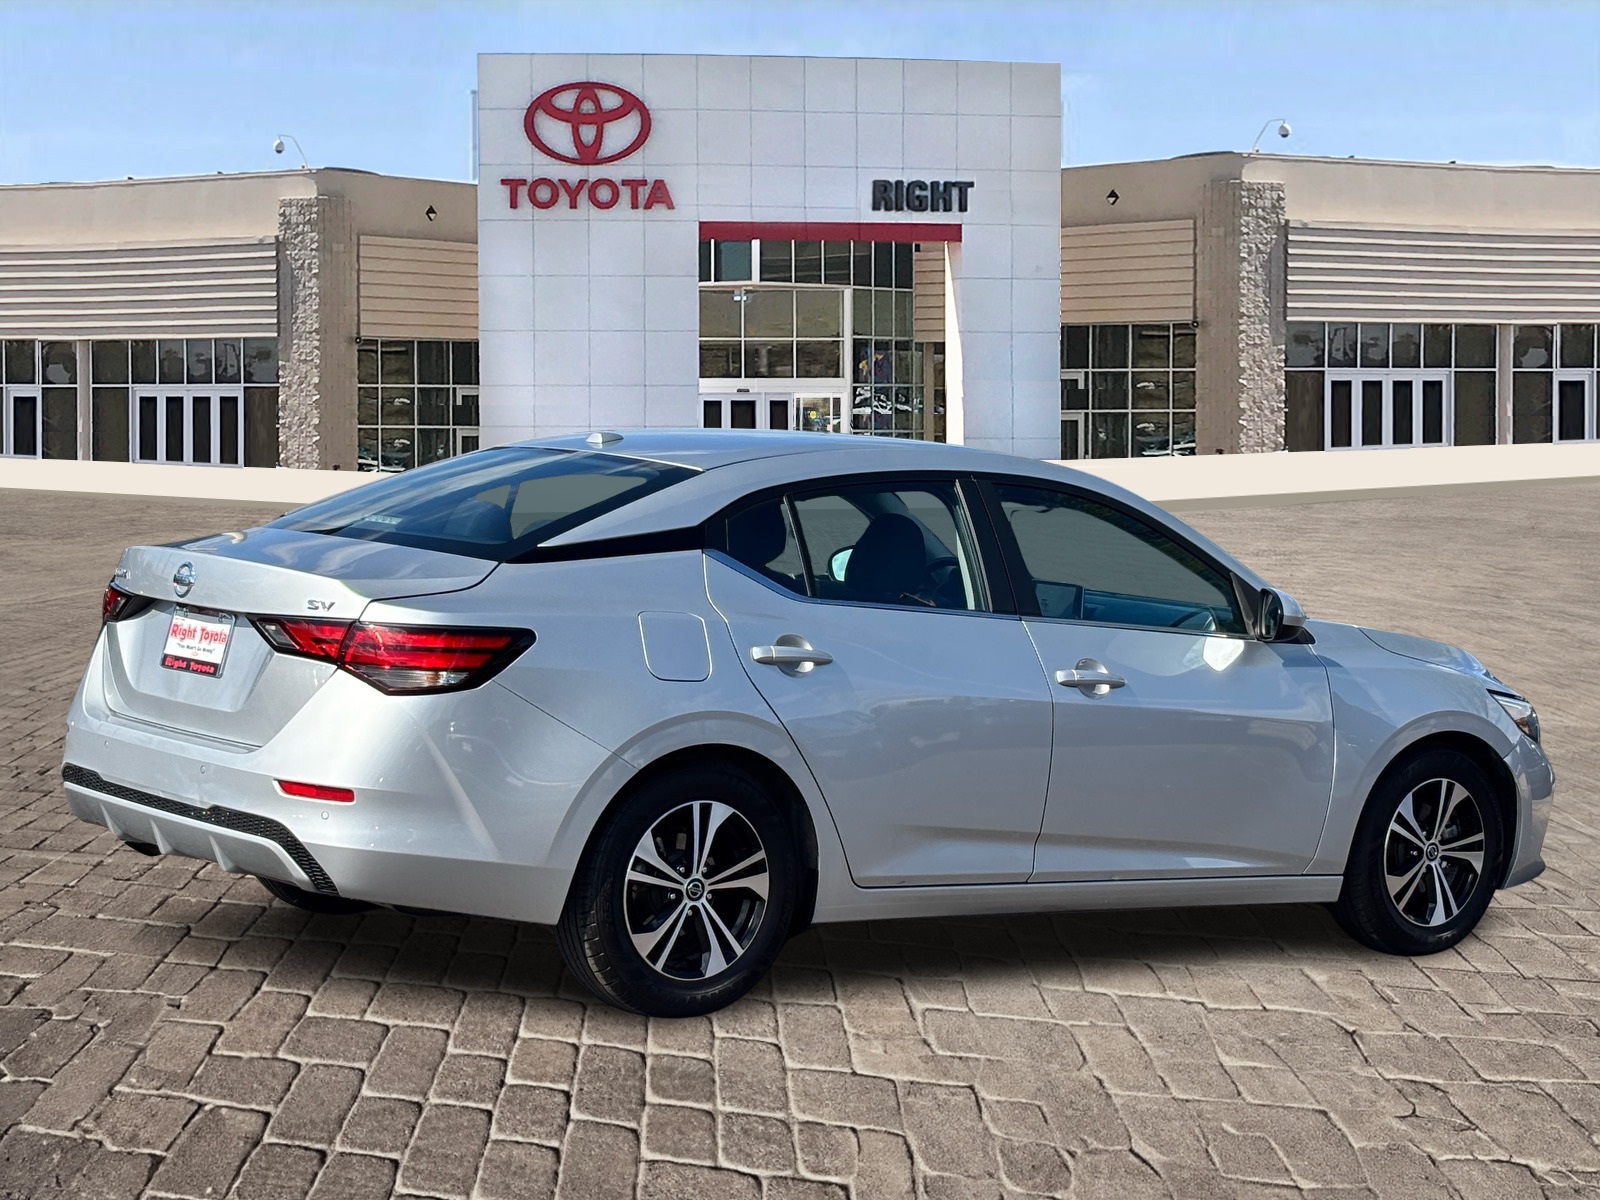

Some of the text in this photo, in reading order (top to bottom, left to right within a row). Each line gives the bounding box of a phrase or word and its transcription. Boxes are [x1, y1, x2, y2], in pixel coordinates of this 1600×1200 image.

[500, 178, 675, 210] TOYOTA
[872, 179, 975, 212] RIGHT
[307, 599, 335, 612] SV
[171, 624, 227, 643] Right Toyota
[165, 656, 214, 672] Right Toyota
